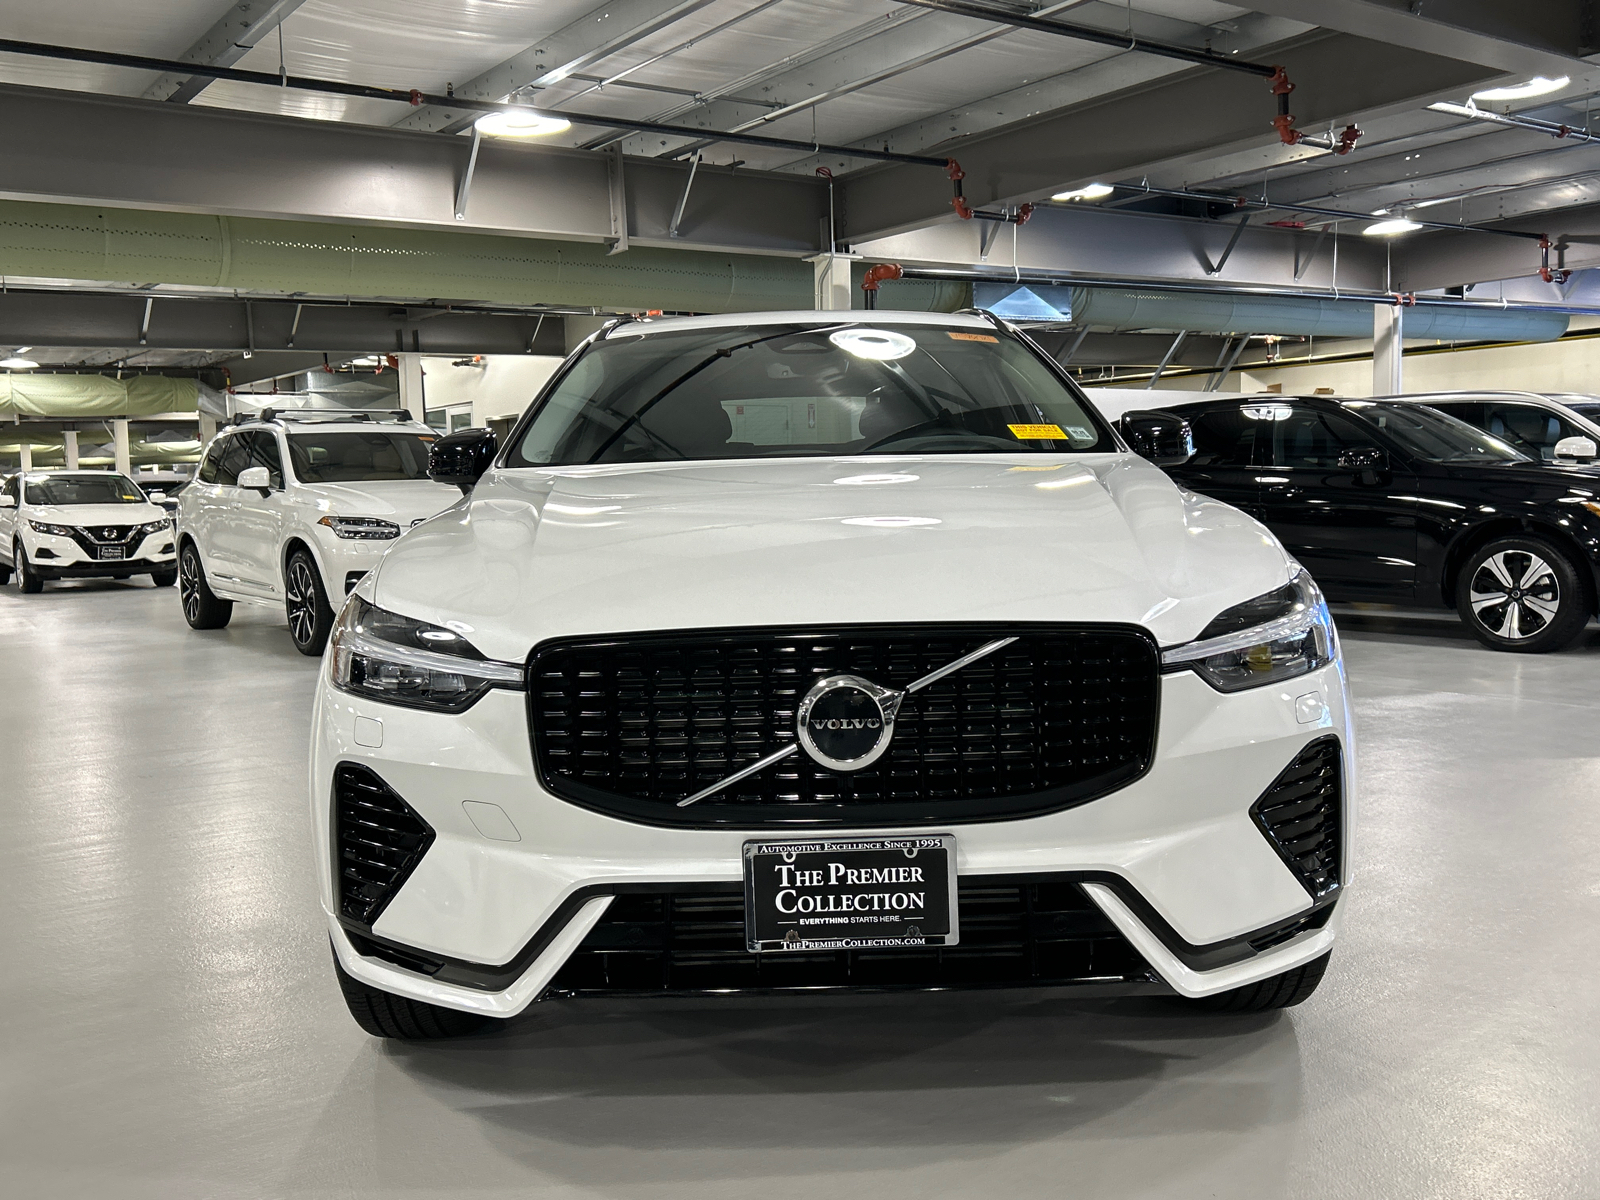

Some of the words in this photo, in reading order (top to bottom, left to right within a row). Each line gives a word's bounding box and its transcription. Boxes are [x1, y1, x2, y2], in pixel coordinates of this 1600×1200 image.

[810, 718, 880, 730] VOLVO
[760, 845, 822, 854] AUTOMOTIVE
[824, 842, 882, 851] EXCELLENCE
[884, 840, 912, 849] SINCE
[915, 839, 941, 848] 1995
[774, 864, 824, 887] THE
[827, 863, 925, 885] PREMIER
[775, 889, 925, 914] COLLECTION
[799, 917, 849, 925] EVERYTHING
[850, 915, 879, 923] STARTS
[879, 915, 902, 923] HERE.
